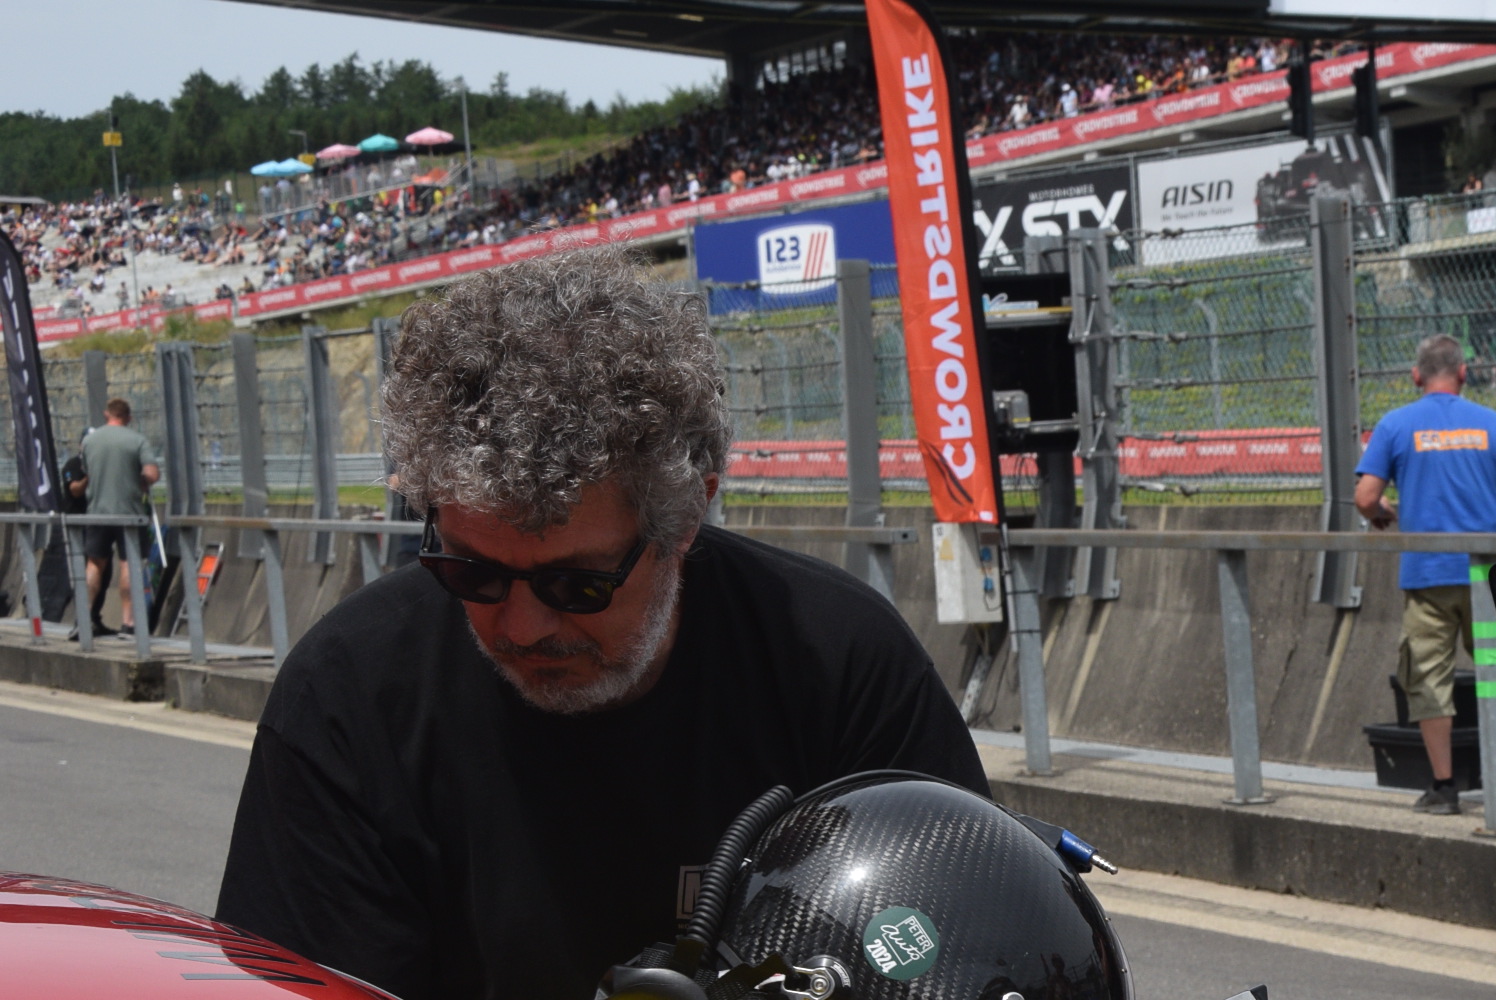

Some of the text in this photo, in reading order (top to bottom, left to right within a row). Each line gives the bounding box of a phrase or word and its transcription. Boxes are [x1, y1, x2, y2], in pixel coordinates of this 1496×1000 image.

[1162, 179, 1233, 208] AISIN
[1022, 190, 1131, 251] STX
[765, 236, 800, 263] 123
[902, 53, 976, 480] CROWDSTRIKE
[904, 918, 931, 950] PETER
[865, 938, 897, 974] 2024
